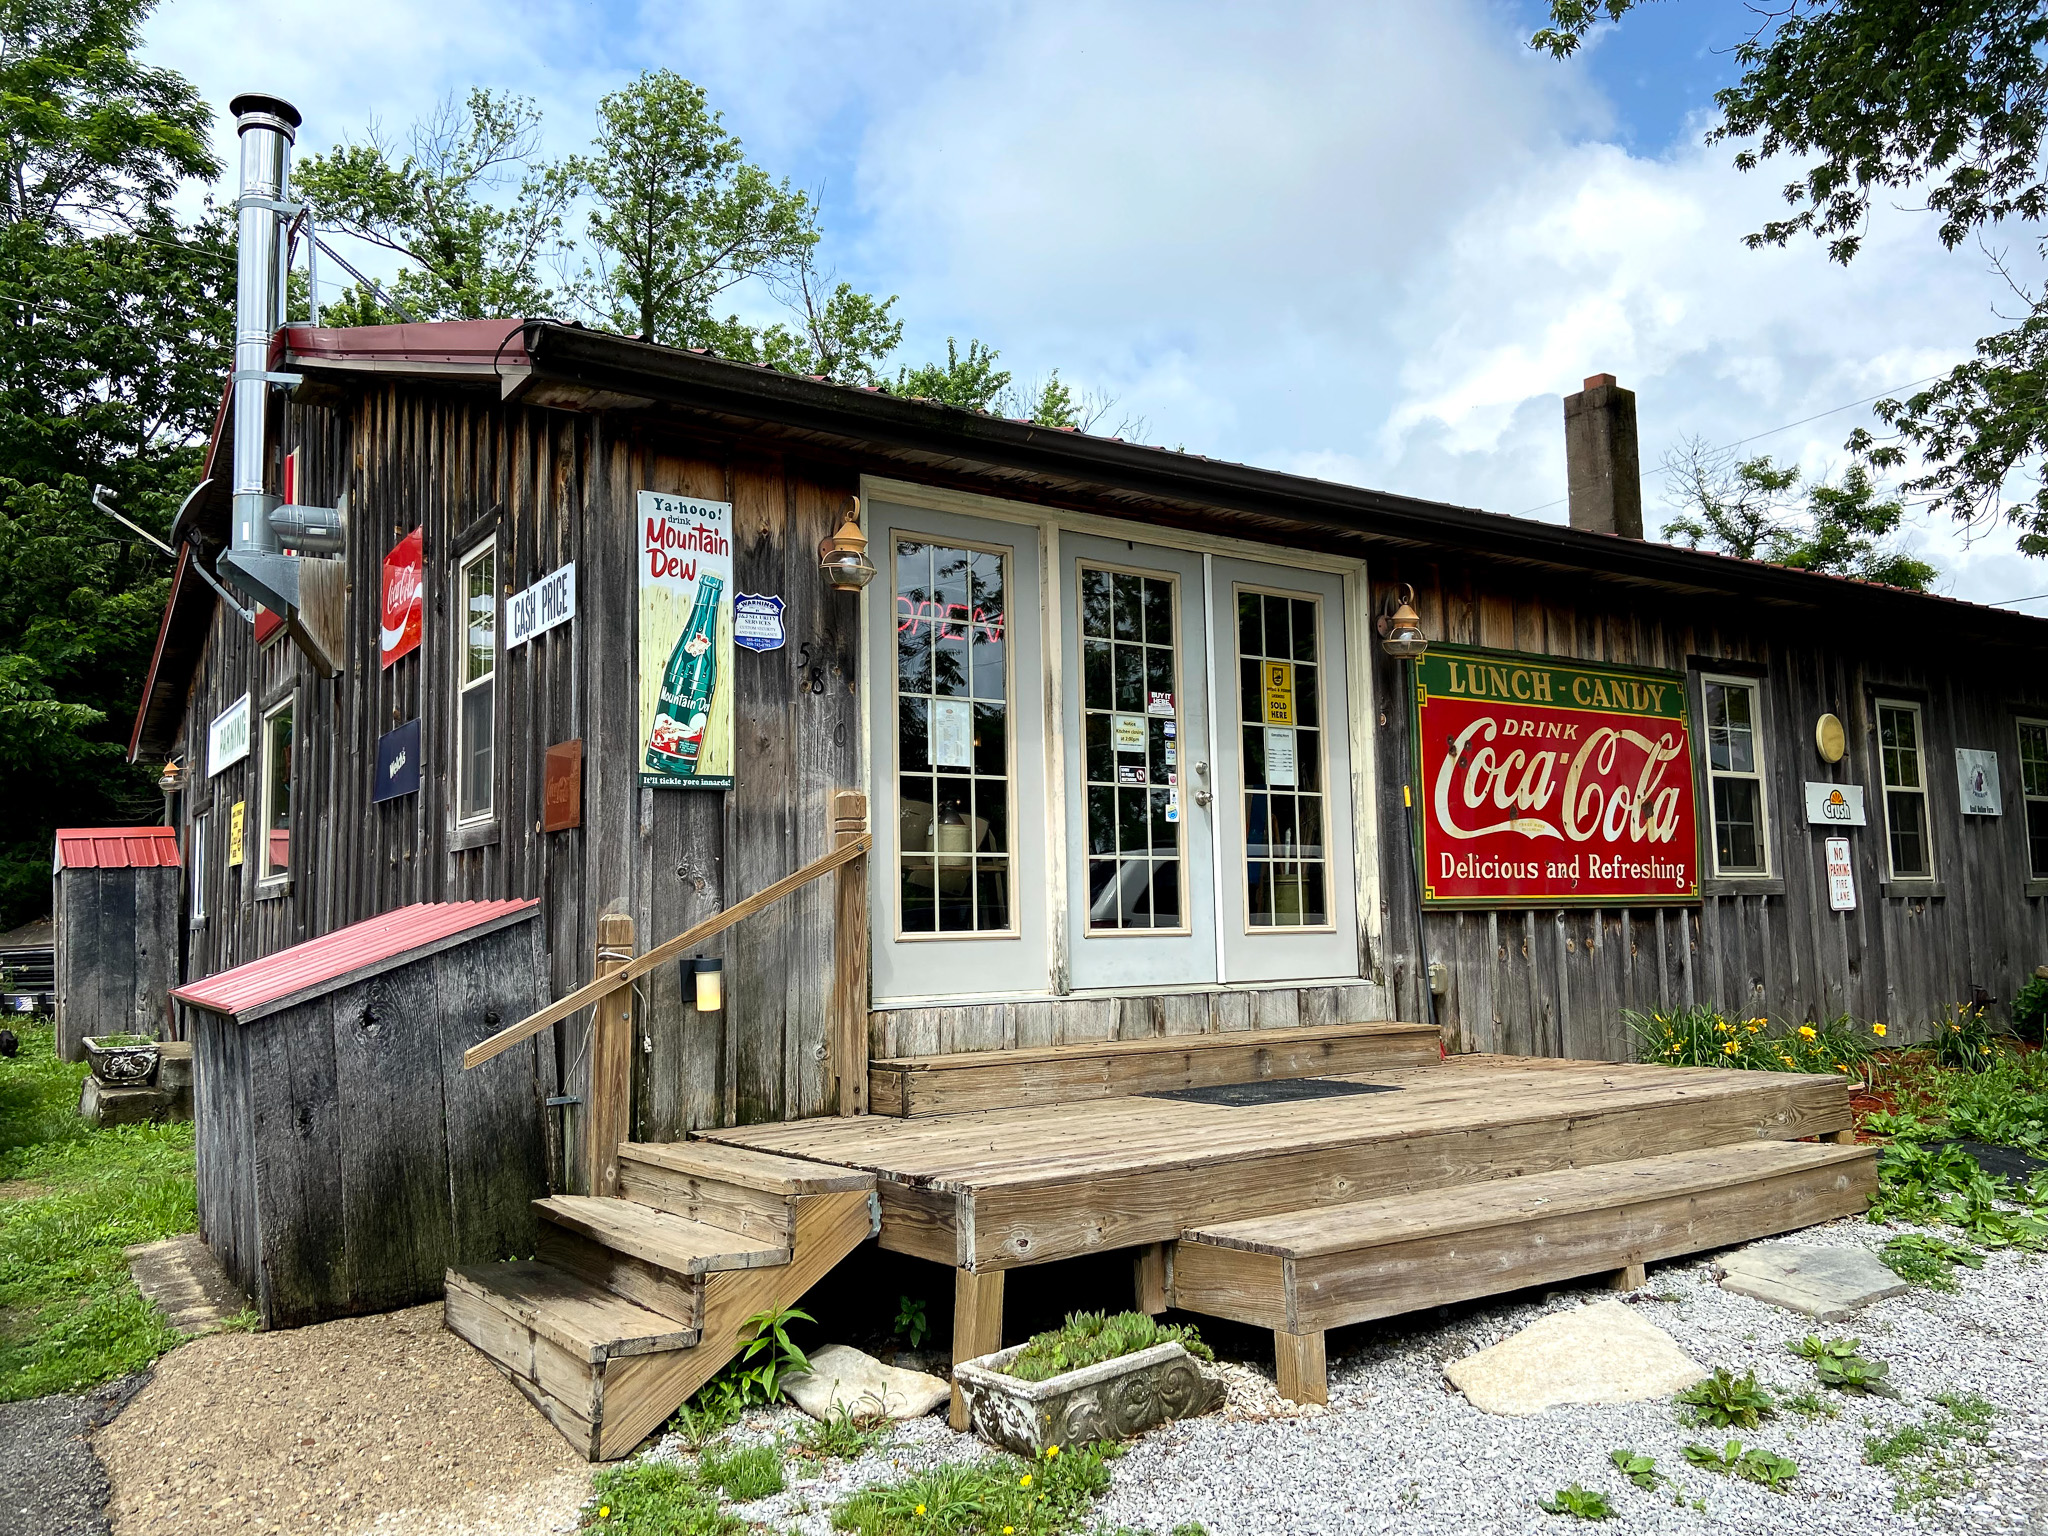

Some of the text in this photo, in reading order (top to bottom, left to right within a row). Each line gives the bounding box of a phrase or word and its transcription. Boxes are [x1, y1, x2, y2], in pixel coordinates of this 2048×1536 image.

[653, 498, 722, 520] Ya-hooo!
[667, 515, 691, 526] drink
[646, 517, 728, 557] Mountain
[645, 548, 697, 581] Dew
[514, 572, 568, 639] CASH PRICE
[741, 600, 775, 609] WARNING
[1151, 691, 1165, 699] BUY
[1447, 662, 1553, 701] LUNCH
[1572, 677, 1666, 712] CANDY
[661, 686, 696, 710] Mountain
[1270, 701, 1287, 710] SOLD
[1271, 711, 1288, 719] HERE
[219, 709, 247, 759] PARKING
[1502, 718, 1579, 740] DRINK
[643, 776, 658, 785] It'll
[659, 777, 682, 786] tickle
[701, 778, 731, 787] innards!
[1822, 798, 1851, 820] Crush
[1833, 847, 1843, 861] NO
[1440, 852, 1685, 888] Delicious and Refreshing
[1829, 863, 1850, 877] PARKING
[1836, 879, 1848, 889] FIRE
[1836, 891, 1850, 901] LANE
